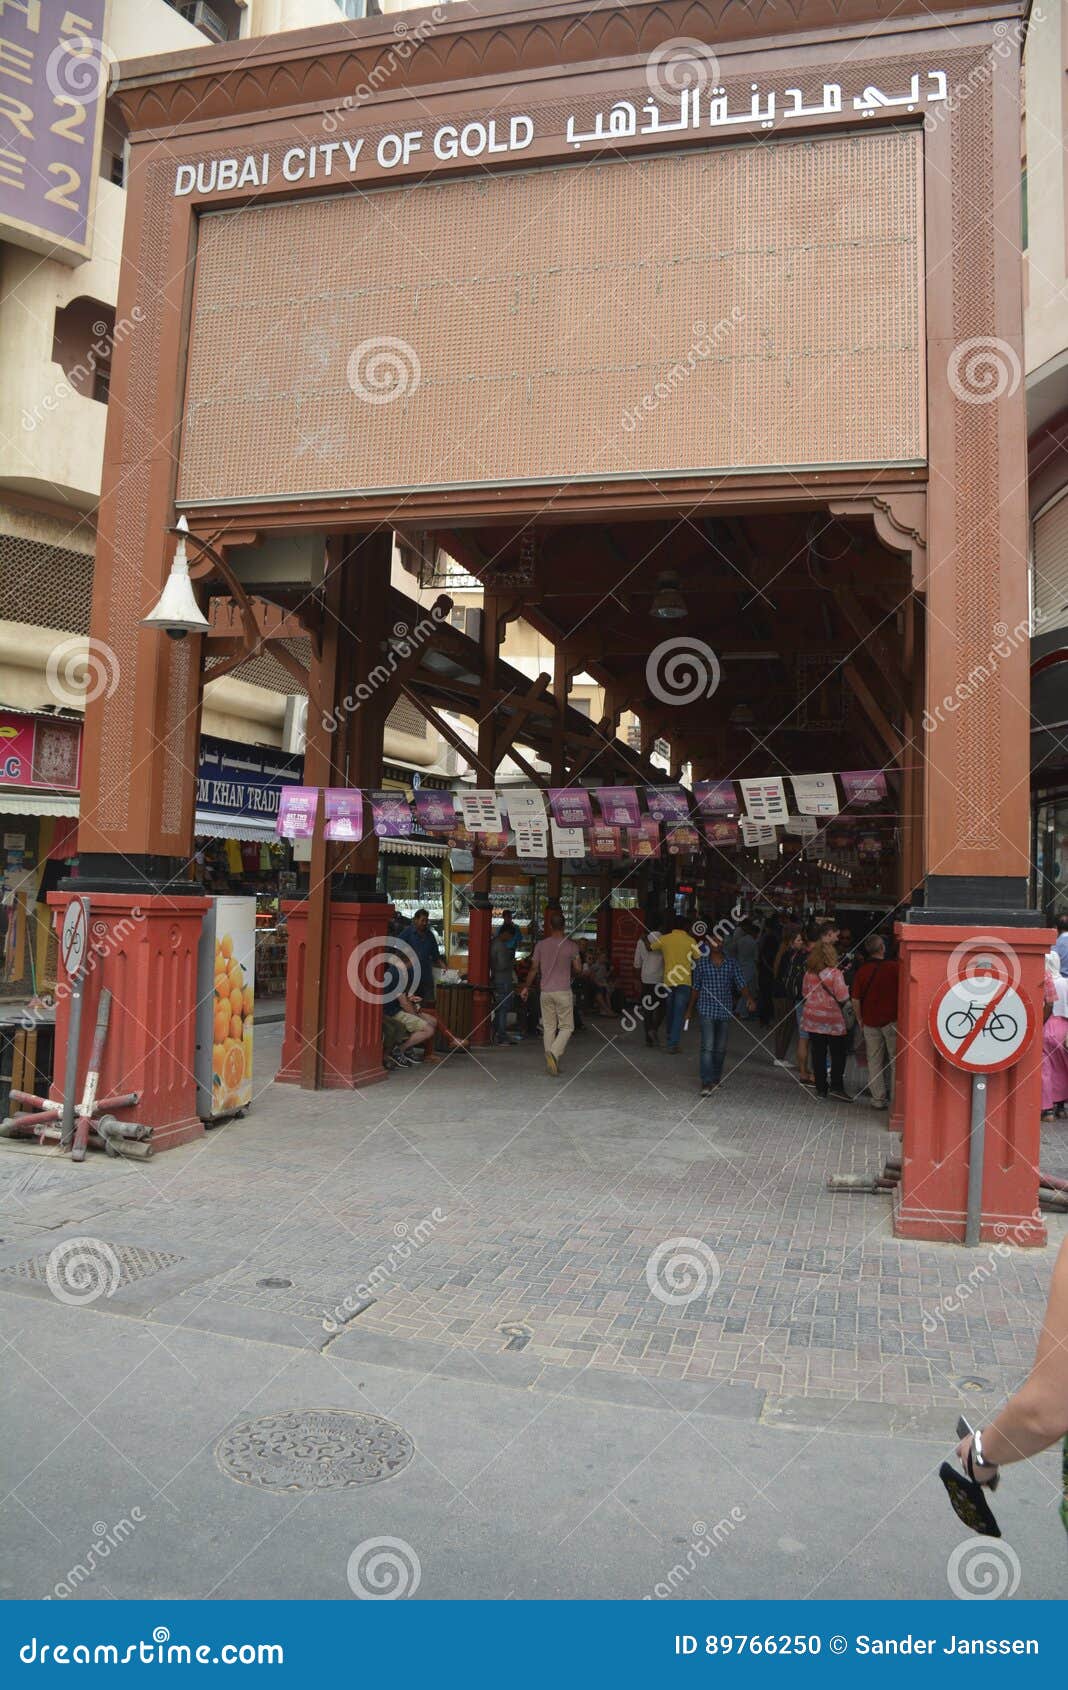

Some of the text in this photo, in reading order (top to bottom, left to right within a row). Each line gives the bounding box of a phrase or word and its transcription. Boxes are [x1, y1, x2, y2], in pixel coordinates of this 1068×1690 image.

[567, 71, 947, 149] دبي مدينة الذهب
[174, 116, 534, 197] DUBAI CITY OF GOLD
[196, 779, 209, 803] M
[212, 780, 245, 808] KHAN
